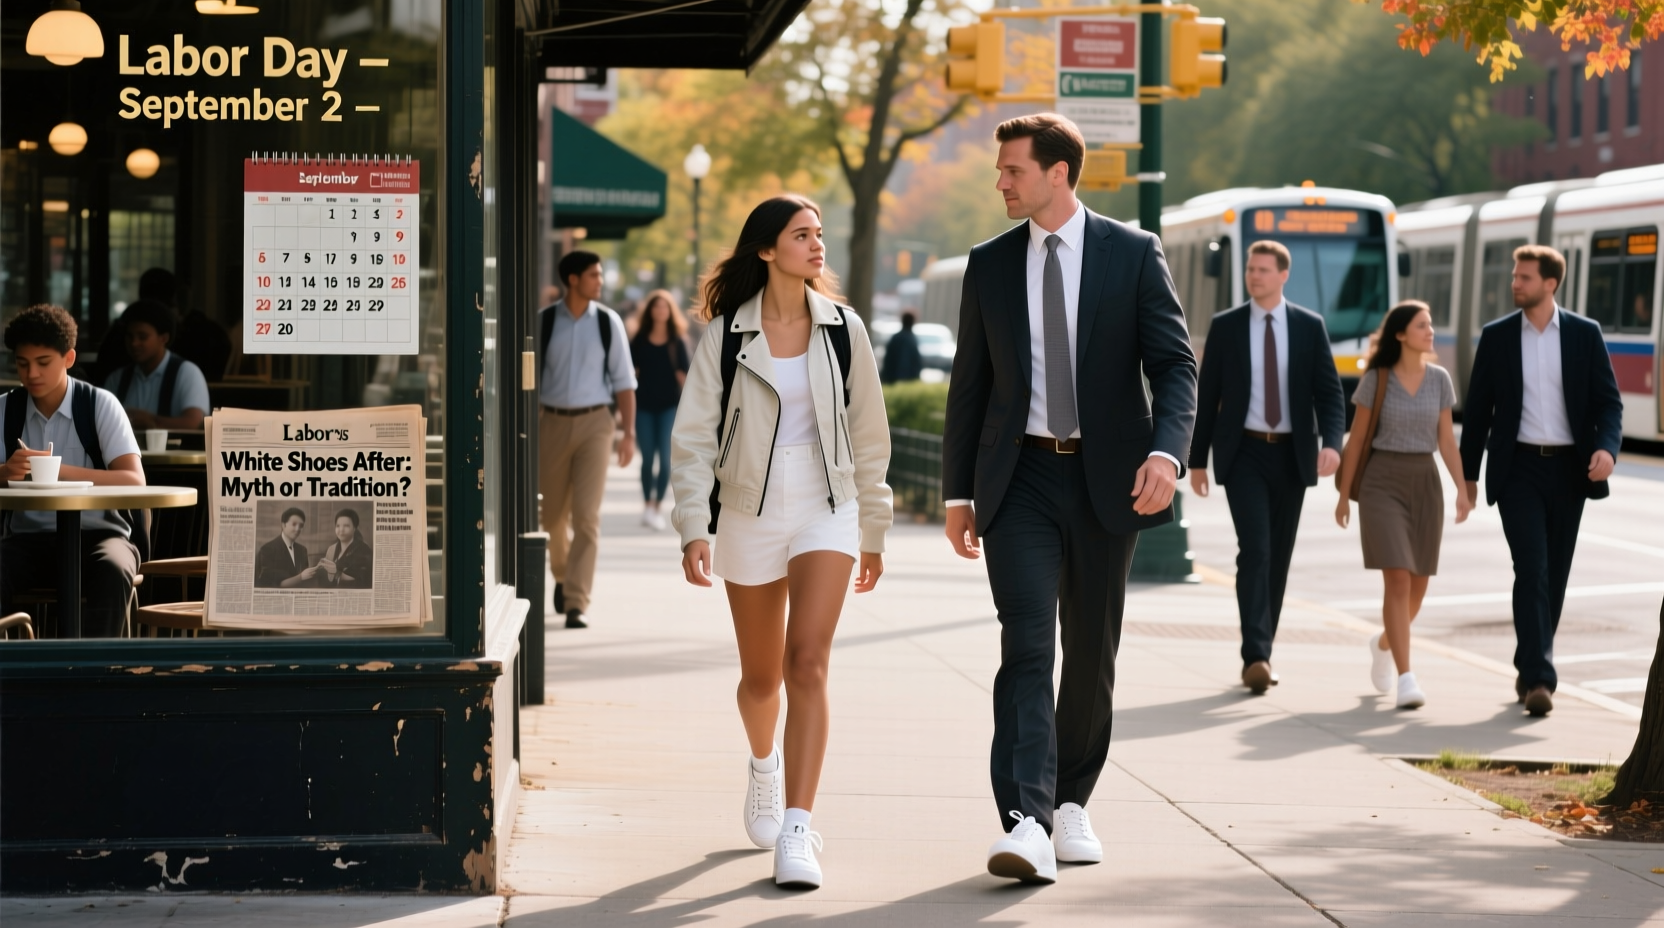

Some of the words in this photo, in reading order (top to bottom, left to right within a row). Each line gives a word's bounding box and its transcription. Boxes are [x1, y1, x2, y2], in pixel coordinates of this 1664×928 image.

[119, 34, 249, 77] Labor
[263, 37, 348, 88] Day
[118, 88, 309, 128] September
[322, 91, 343, 121] 2
[328, 208, 336, 220] 1
[373, 231, 381, 243] 9
[395, 230, 404, 243] 9
[282, 252, 290, 264] 7
[350, 253, 358, 265] 9
[257, 275, 271, 288] 10
[301, 275, 317, 289] 14
[391, 276, 407, 289] 26
[277, 322, 294, 335] 20
[221, 451, 283, 471] White
[288, 451, 348, 471] Shoes
[353, 451, 412, 471] After:
[221, 476, 275, 503] Myth
[280, 481, 303, 497] or
[307, 476, 412, 497] Tradition?
